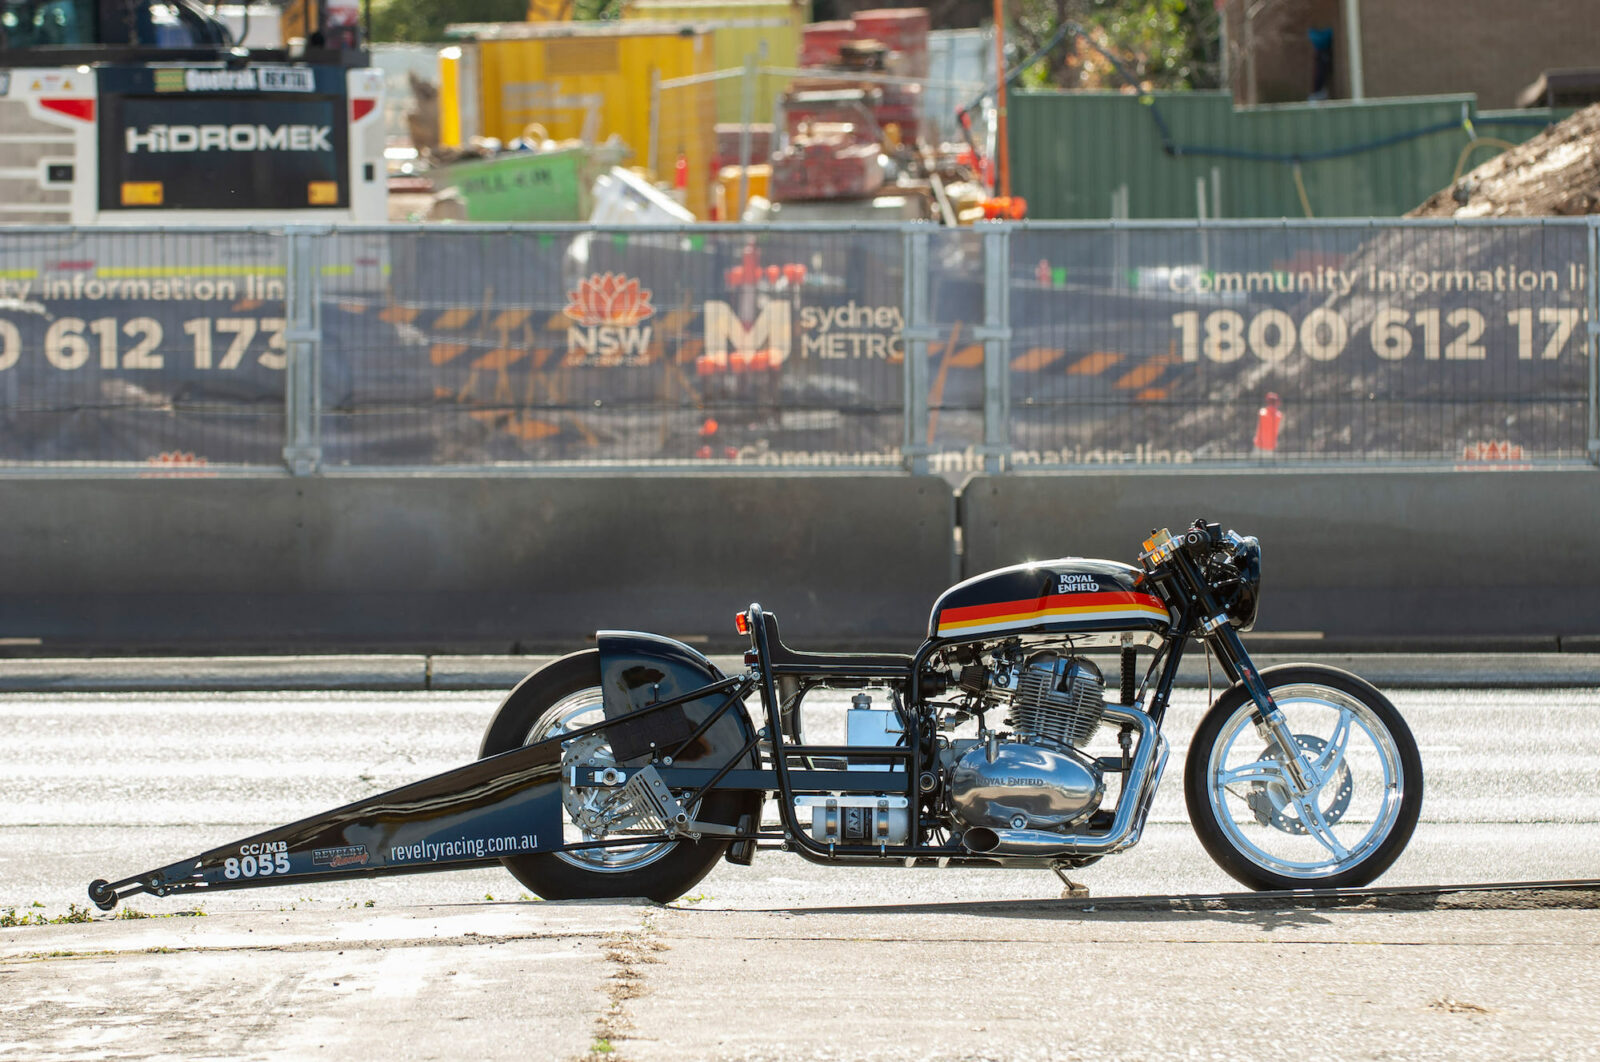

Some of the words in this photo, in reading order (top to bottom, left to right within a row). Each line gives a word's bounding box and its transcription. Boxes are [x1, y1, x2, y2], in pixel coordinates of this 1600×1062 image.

[42, 272, 237, 300] information
[246, 274, 286, 300] lin
[1168, 265, 1357, 296] Community
[1367, 264, 1559, 292] information
[1569, 262, 1585, 291] li
[44, 316, 165, 371] 612
[567, 326, 653, 355] NSW
[1172, 308, 1348, 363] 1800
[1370, 306, 1487, 361] 612
[1507, 306, 1589, 361] 17
[1058, 583, 1100, 594] ENFIELD
[1060, 574, 1094, 584] ROYAL
[976, 776, 1006, 786] ROYAL
[1007, 776, 1044, 786] ENFIELD
[239, 841, 288, 856] CC/MB
[390, 834, 538, 861] revelryracing.com.au
[223, 852, 291, 879] 8055
